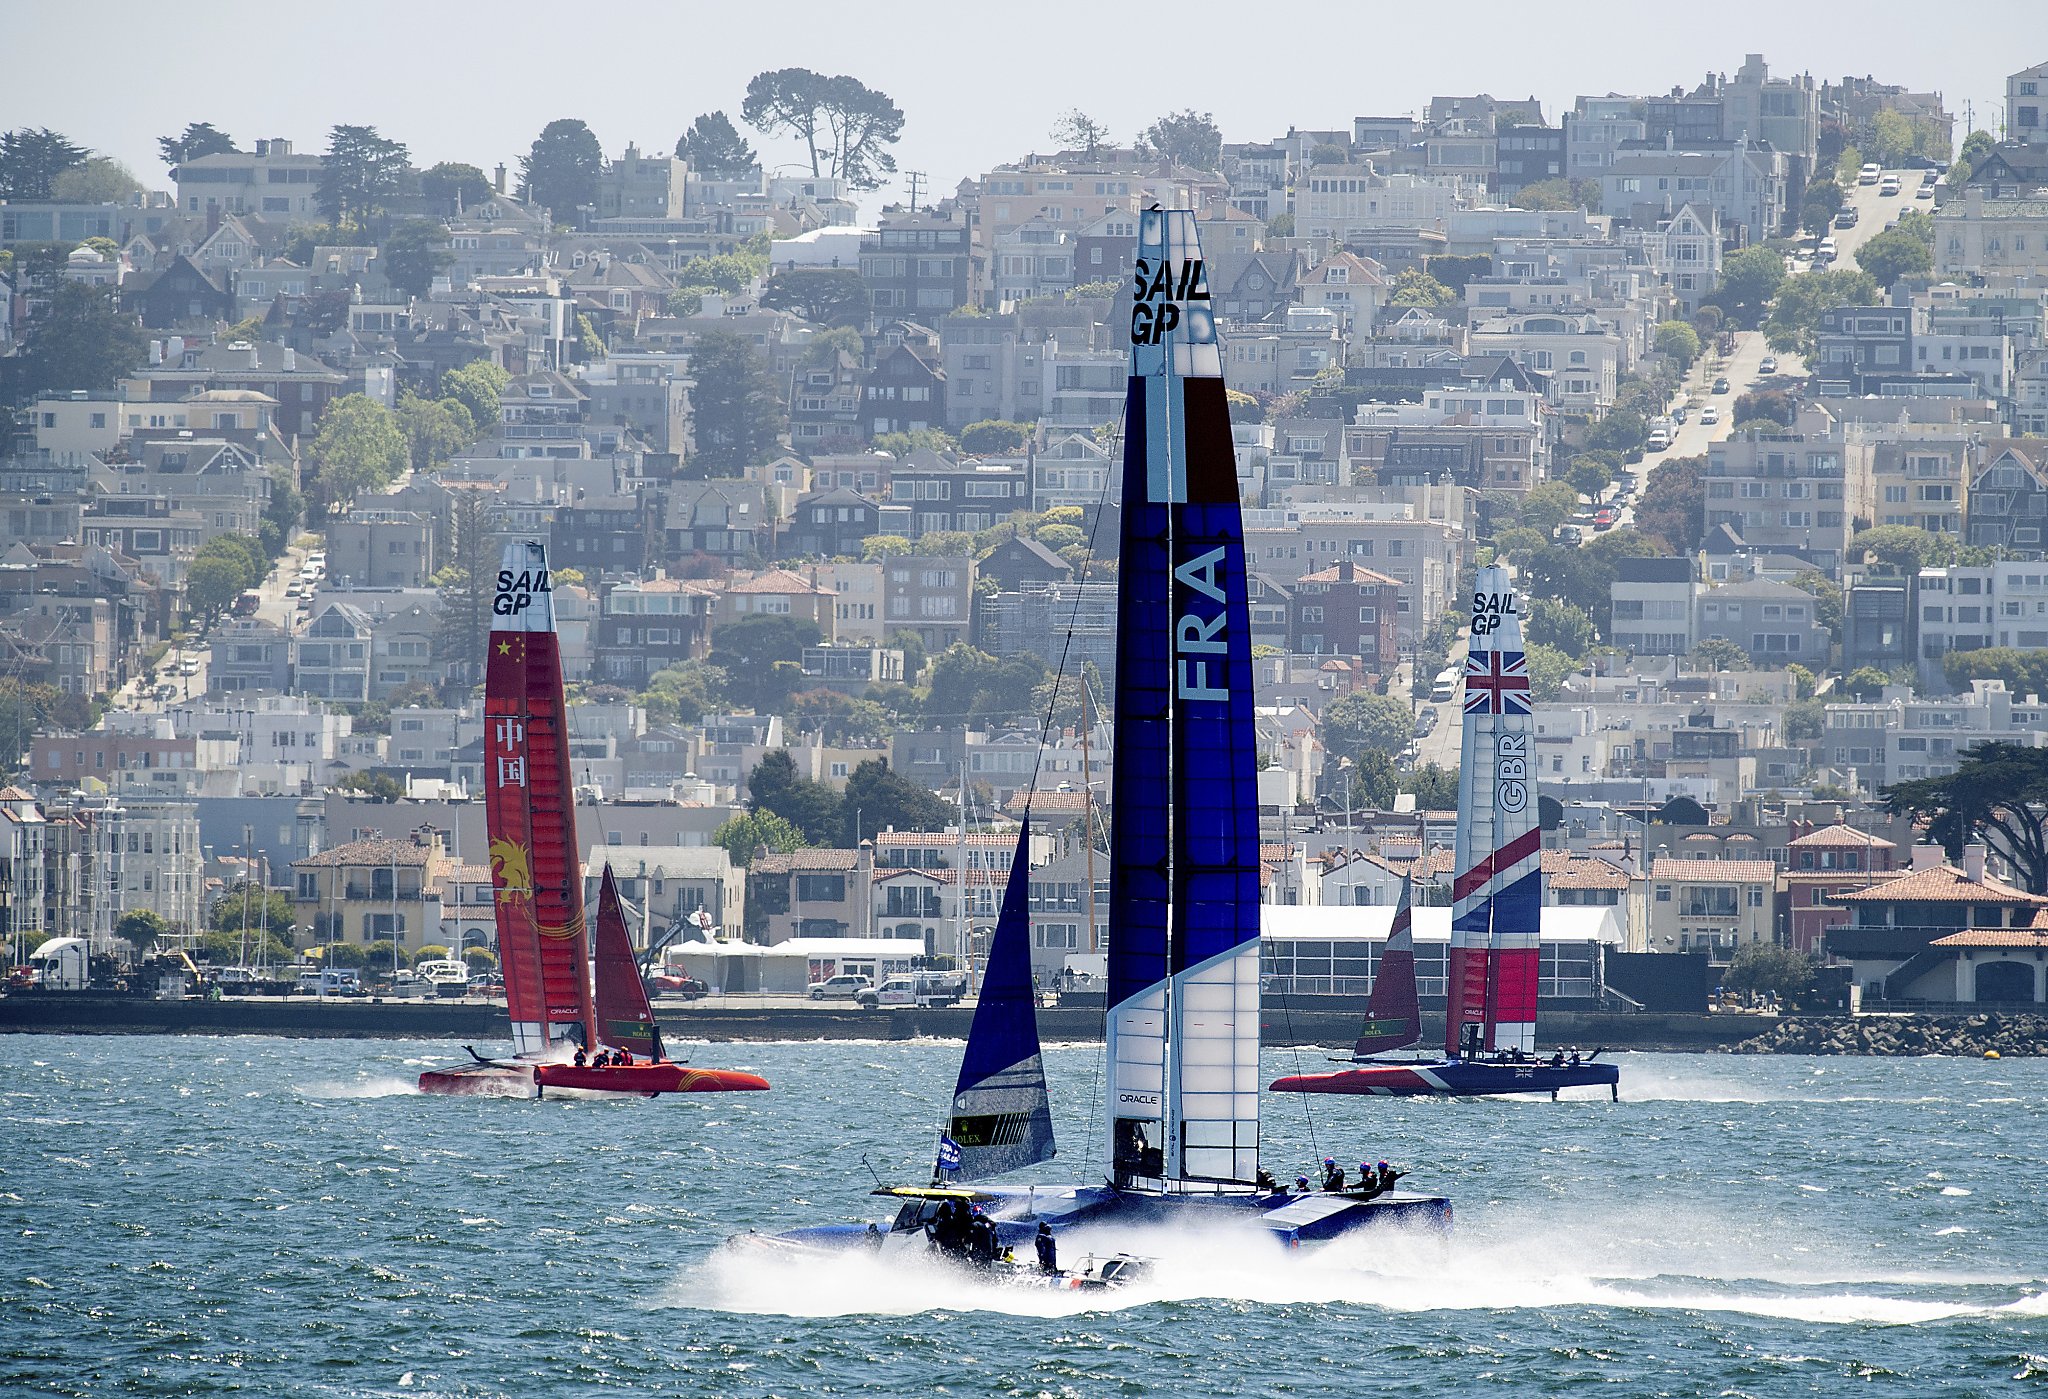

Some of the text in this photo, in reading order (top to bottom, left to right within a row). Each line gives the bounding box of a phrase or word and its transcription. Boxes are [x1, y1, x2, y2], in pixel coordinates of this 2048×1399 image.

[1134, 259, 1210, 301] SAIL
[1131, 303, 1180, 345] GP
[497, 570, 552, 592] SAIL
[493, 593, 532, 615] GP
[1473, 592, 1517, 614] SAIL
[1174, 545, 1229, 701] FRA
[1471, 614, 1501, 635] GP
[496, 718, 526, 788] 中国
[1498, 734, 1528, 813] GBR
[1120, 1094, 1158, 1104] ORACLE
[952, 1134, 981, 1144] ROLEX
